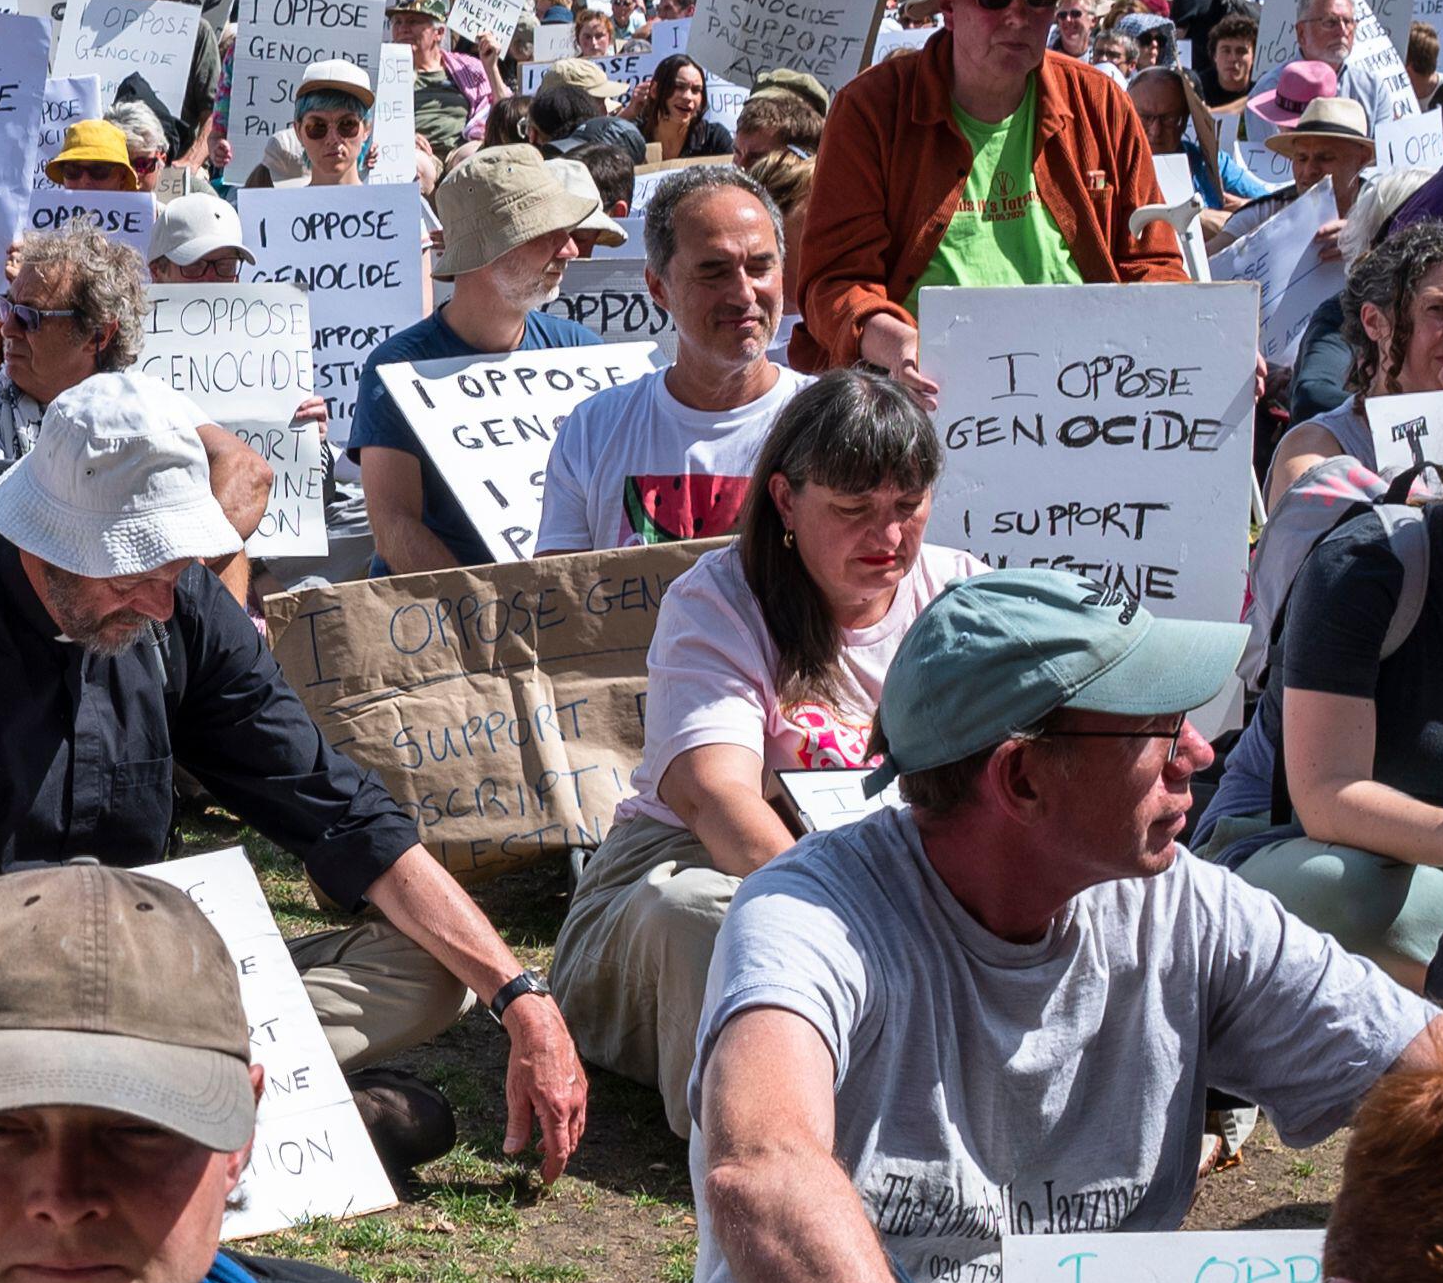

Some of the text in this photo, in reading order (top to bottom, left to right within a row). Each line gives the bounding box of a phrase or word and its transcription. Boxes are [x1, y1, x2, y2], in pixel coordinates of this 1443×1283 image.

[102, 6, 190, 38] OPPOSE
[672, 26, 679, 49] I
[729, 4, 865, 60] SUPPORT
[74, 35, 179, 67] GENOCIDE
[707, 16, 838, 77] PALESTINE
[31, 204, 144, 234] OPPOSE
[259, 209, 399, 249] I OPPOSE
[146, 295, 306, 339] I OPPOSE
[141, 349, 314, 394] GENOCIDE
[411, 364, 627, 410] I OPPOSE
[989, 352, 1203, 402] I OPPOSE
[945, 409, 1223, 454] GENOCIDE
[482, 477, 511, 511] I
[963, 501, 1173, 541] I SUPPORT
[298, 604, 343, 688] I
[389, 587, 567, 656] OPPOSE
[393, 697, 589, 770] SUPPORT
[812, 785, 865, 815] I
[880, 1172, 928, 1233] The
[929, 1254, 961, 1283] 020
